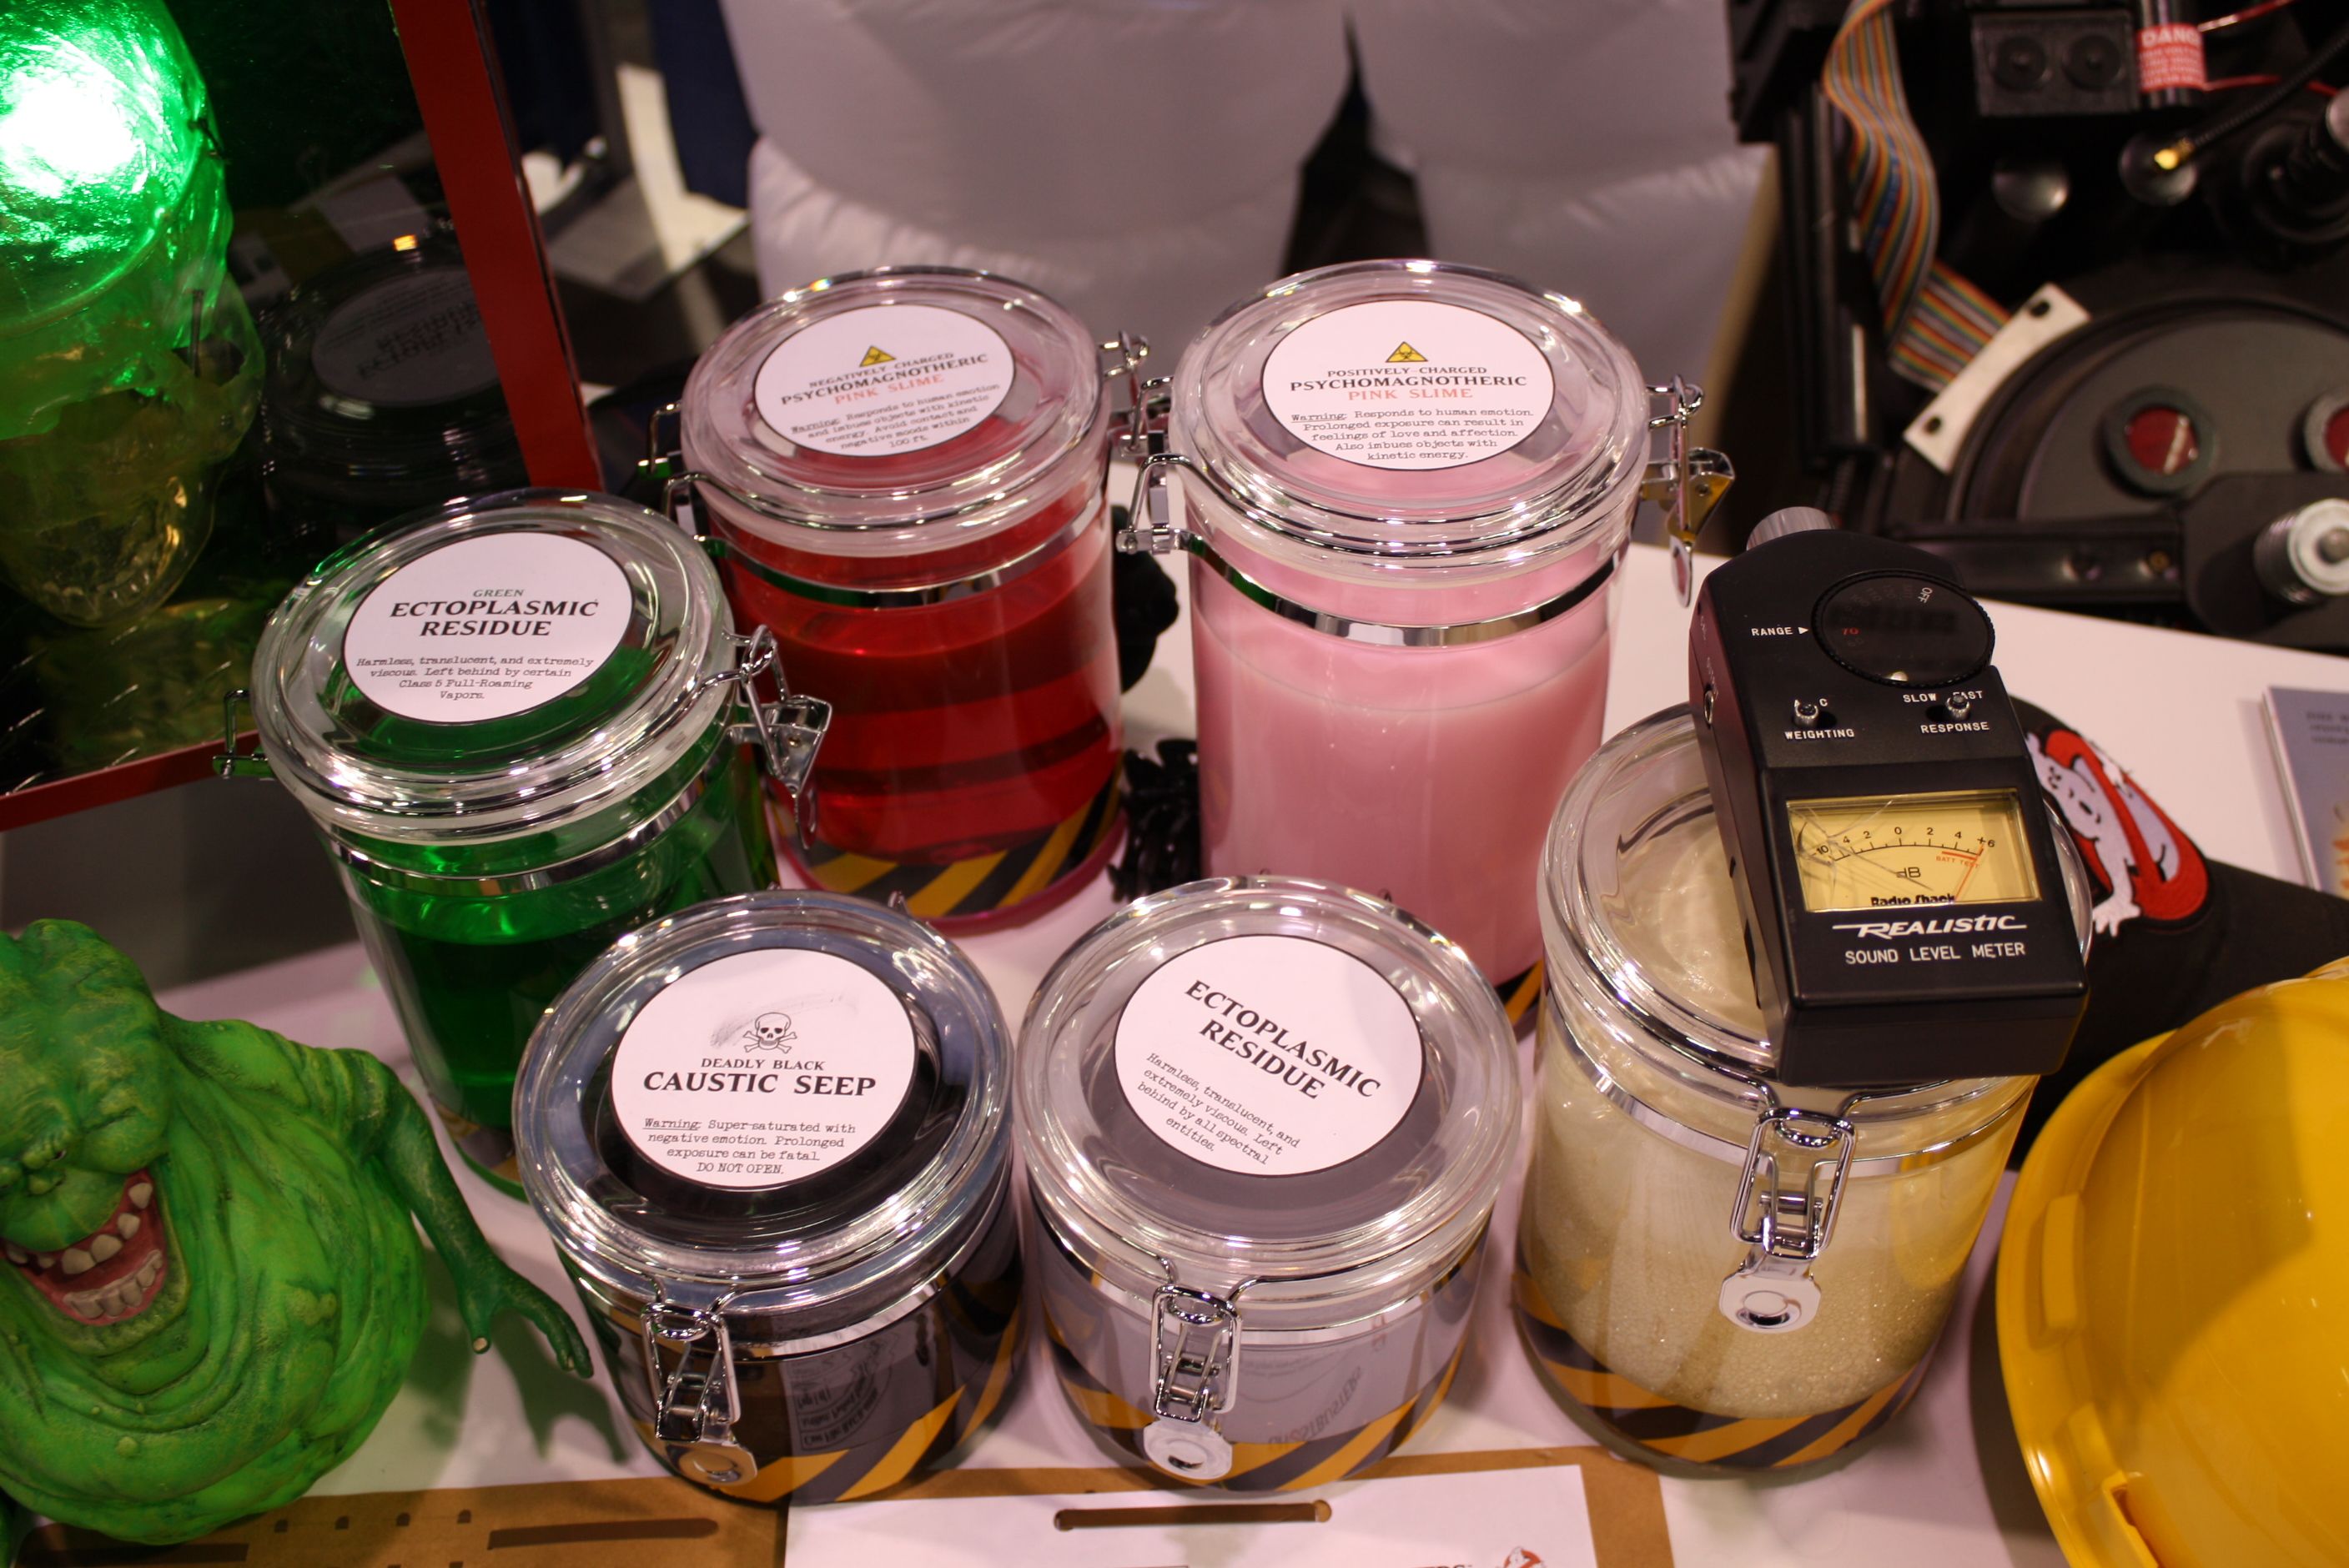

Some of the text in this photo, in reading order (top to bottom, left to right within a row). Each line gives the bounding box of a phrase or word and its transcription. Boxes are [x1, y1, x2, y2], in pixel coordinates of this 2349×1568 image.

[809, 352, 954, 388] NEGATIVELY CHARGED
[1327, 366, 1487, 377] POSITIVELY CHARGED
[781, 354, 988, 405] PSYCHOMAGNOTHERIC
[1290, 375, 1527, 391] PSYCHOMAGNOTHERIC
[835, 374, 944, 405] PINK SLIME
[1348, 388, 1473, 401] PINK SLIME
[846, 405, 898, 420] Responds
[902, 400, 914, 409] to
[917, 393, 953, 405] human
[1354, 410, 1415, 419] Responds
[1419, 408, 1432, 416] to
[1435, 407, 1477, 416] human
[807, 394, 989, 439] and imbues objects with kinetic
[874, 420, 908, 433] Avoid
[910, 411, 954, 425] contact
[957, 405, 978, 415] and
[1303, 421, 1371, 431] Prolonged
[1374, 420, 1435, 430] exposure
[1463, 418, 1506, 427] result
[840, 417, 969, 450] negative moods within
[1310, 431, 1369, 442] feelings
[1371, 430, 1386, 440] of
[1390, 429, 1420, 439] love
[1422, 428, 1447, 437] and
[889, 438, 910, 449] 100
[1335, 439, 1497, 451] Also imbues objects with
[1366, 451, 1469, 460] kinetic energy.
[472, 589, 525, 598] GREEN
[1918, 586, 1933, 604] OFF
[389, 600, 599, 617] ECTOPLASMIC
[419, 620, 552, 636] RESIDUE
[1751, 626, 1793, 636] RANGE
[356, 656, 594, 668] Harmless, translucent, and extremely
[425, 667, 455, 676] Left
[457, 667, 500, 676] behind
[505, 667, 520, 677] by
[522, 668, 572, 677] certain
[399, 679, 534, 690] Class 5 Full-Roaming
[1819, 698, 1828, 706] C
[1903, 692, 1937, 702] SLOW
[1784, 728, 1854, 740] WEIGHTING
[1920, 721, 1989, 734] RESPONSE
[1864, 830, 1872, 840] 2
[1894, 827, 1903, 835] 0
[1927, 827, 1934, 835] 2
[1954, 831, 1962, 840] 4
[1832, 914, 2028, 939] REALISTIC
[1845, 942, 2026, 965] SOUND LEVEL METER
[1185, 979, 1381, 1098] ECTOPLASMIC
[701, 1058, 826, 1071] DEADLY BLACK
[1199, 1019, 1326, 1100] RESIDUE
[643, 1071, 876, 1096] CAUSTIC SEEP
[1146, 1053, 1301, 1148] Harmless, translucent, and
[1144, 1068, 1283, 1156] extremely viscous. Left
[825, 1123, 857, 1133] with
[1137, 1081, 1269, 1165] behind by all spectral
[647, 1133, 709, 1145] negative
[774, 1135, 845, 1149] Prolonged
[666, 1148, 729, 1159] exposure
[732, 1149, 756, 1159] can
[760, 1150, 776, 1159] be
[696, 1162, 785, 1175] DO NOT OPEN.
